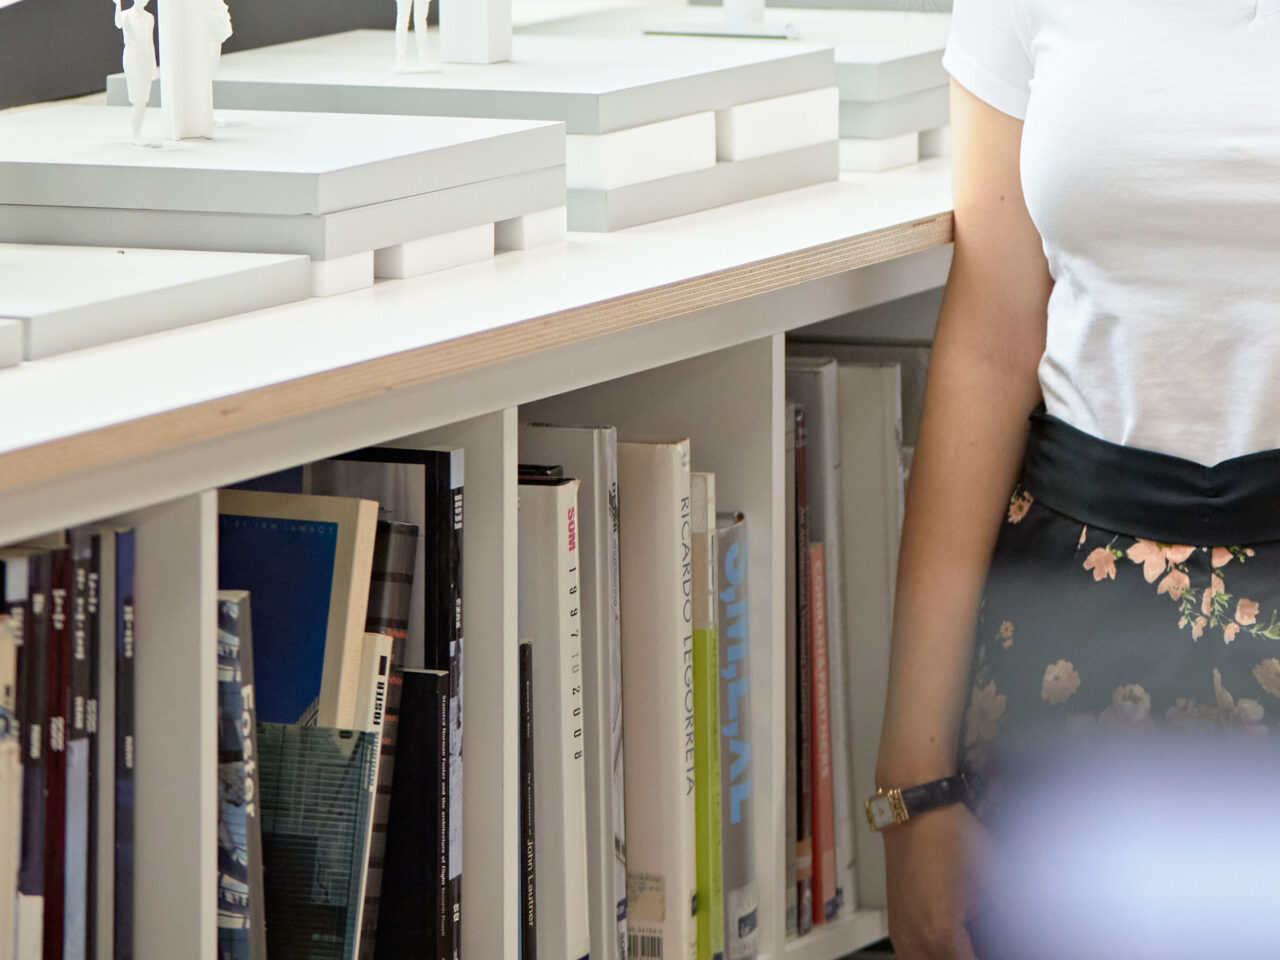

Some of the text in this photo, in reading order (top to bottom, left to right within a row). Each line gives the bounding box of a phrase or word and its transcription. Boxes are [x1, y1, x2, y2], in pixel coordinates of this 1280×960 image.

[567, 506, 576, 551] SOM
[681, 496, 695, 795] RICARDO LEGORRETA
[372, 681, 385, 725] FOSTER
[241, 683, 257, 818] Foster
[527, 837, 535, 871] John
[527, 874, 535, 927] Lautner
